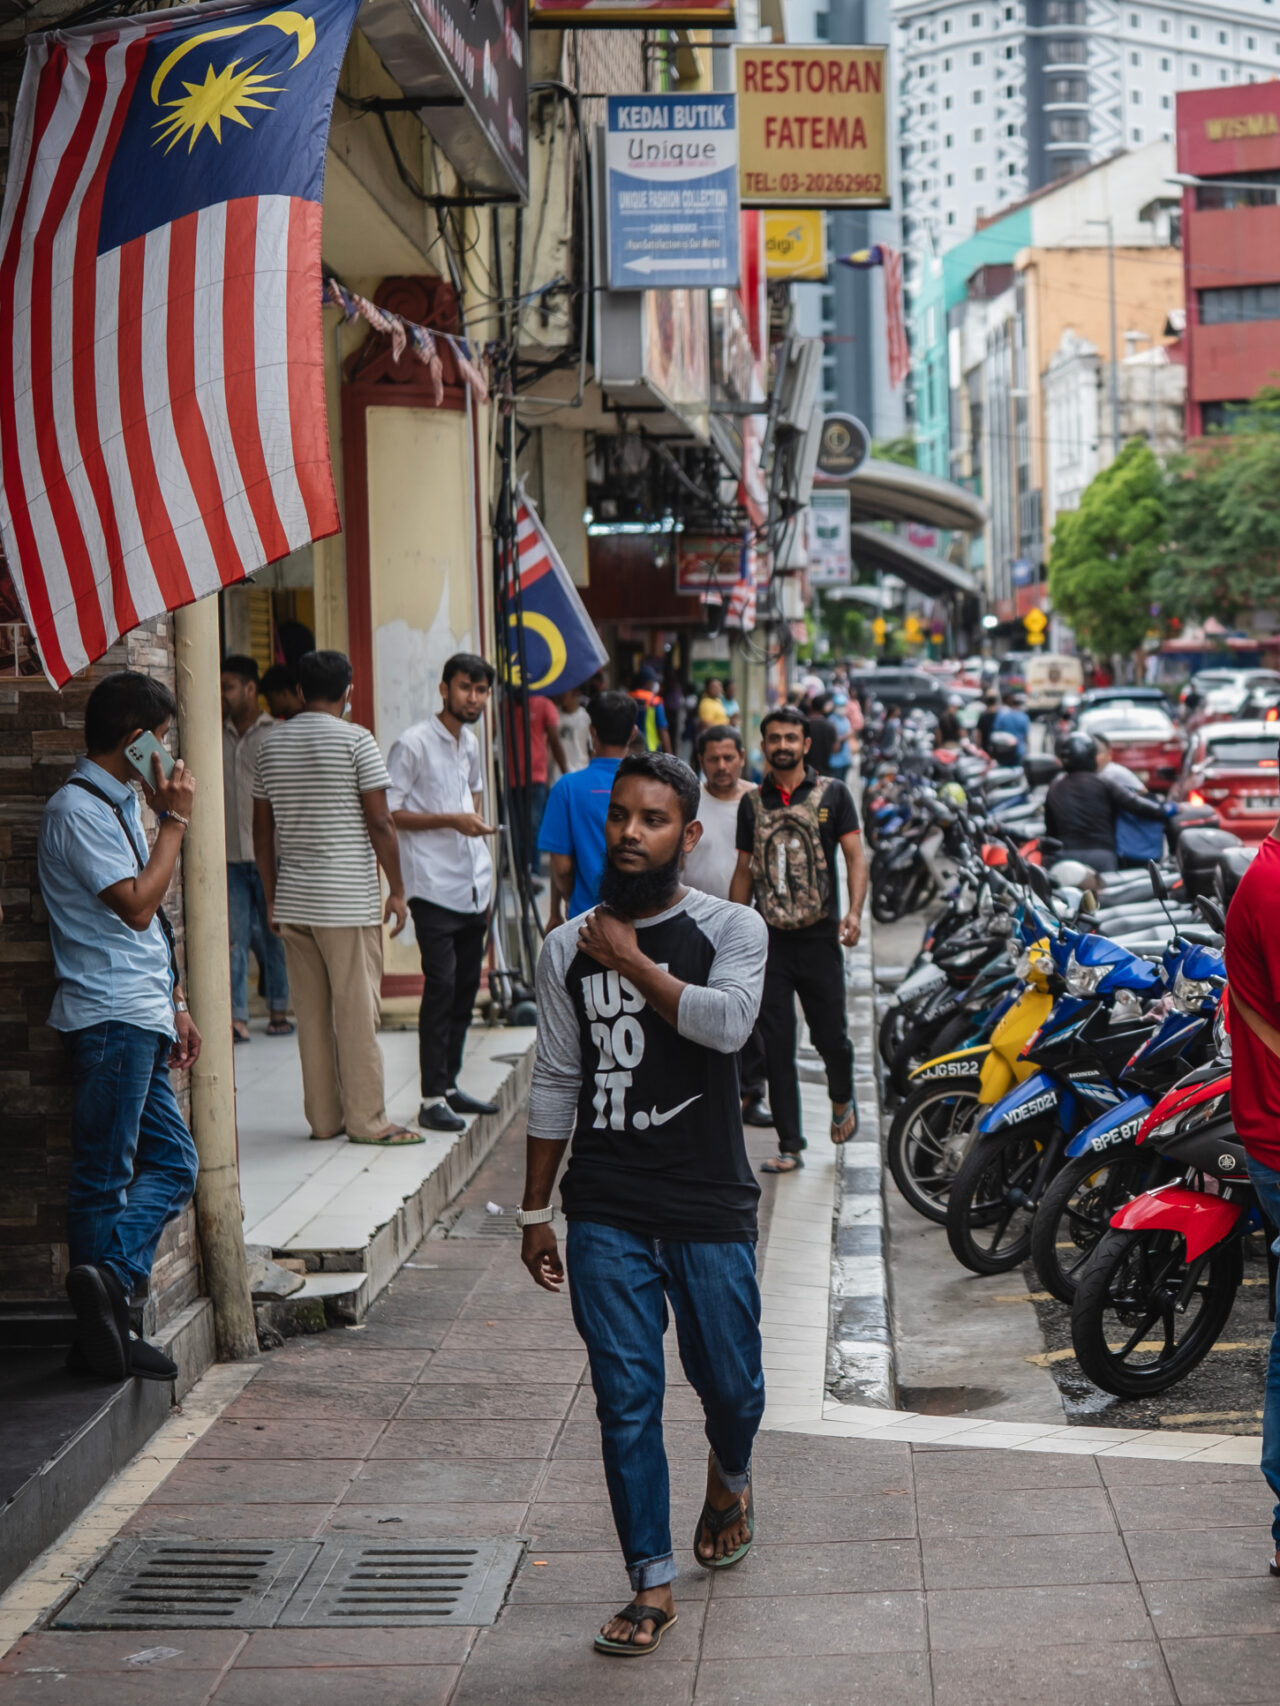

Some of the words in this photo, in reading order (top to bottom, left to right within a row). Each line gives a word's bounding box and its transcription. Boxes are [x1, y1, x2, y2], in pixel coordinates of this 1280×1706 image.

[744, 60, 882, 94] RESTORAN
[617, 106, 669, 130] KEDAI
[674, 105, 727, 130] BUTIK
[1206, 114, 1279, 141] WISMA
[765, 116, 868, 150] FATEMA
[628, 137, 717, 166] Unique
[745, 172, 777, 193] TEL:
[780, 172, 882, 193] 03-20262962
[581, 963, 669, 1021] JUS
[590, 1015, 646, 1070] DO
[921, 1061, 979, 1079] JJG5122
[1069, 1070, 1100, 1078] HONDA
[1003, 1092, 1058, 1126] VDE5021
